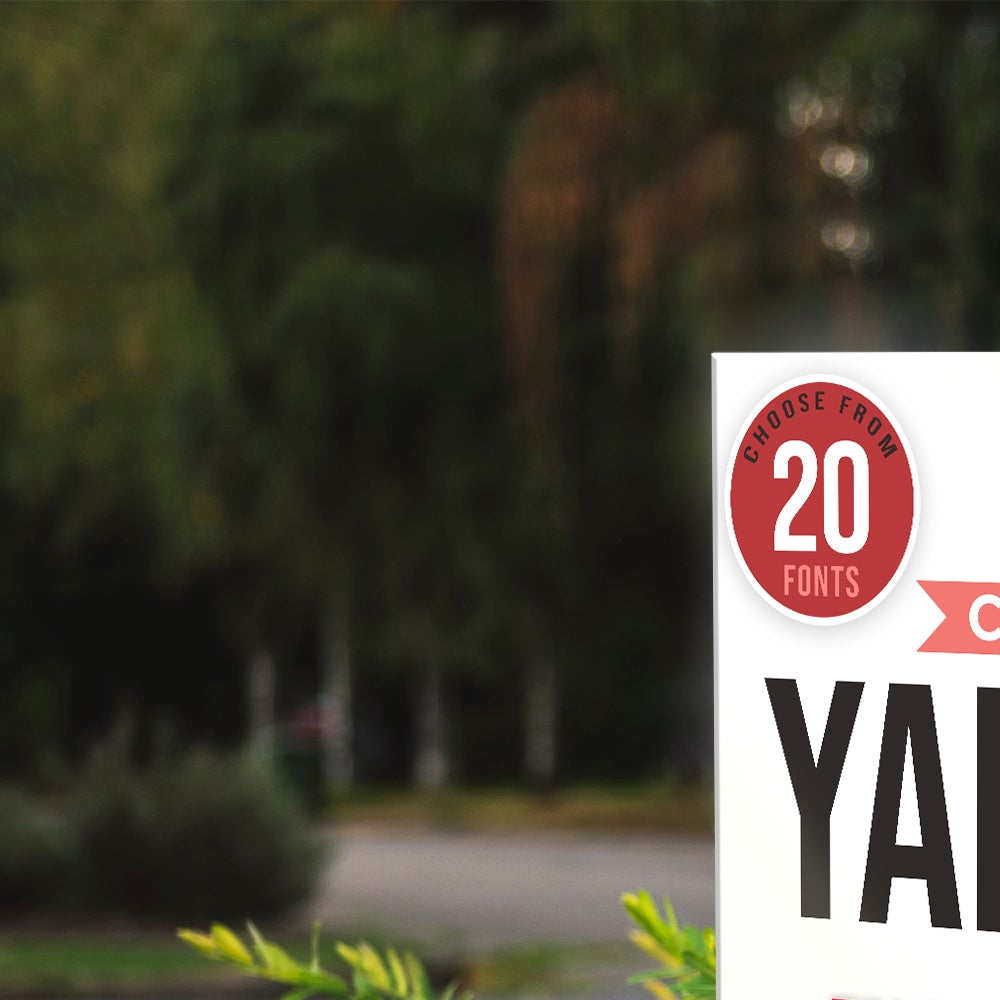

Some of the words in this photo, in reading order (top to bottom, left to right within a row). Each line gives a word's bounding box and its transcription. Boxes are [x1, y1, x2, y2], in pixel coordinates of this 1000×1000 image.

[743, 391, 825, 464] CHOOSE
[839, 395, 898, 458] FROM
[773, 439, 870, 555] 20
[783, 564, 860, 598] FONTS
